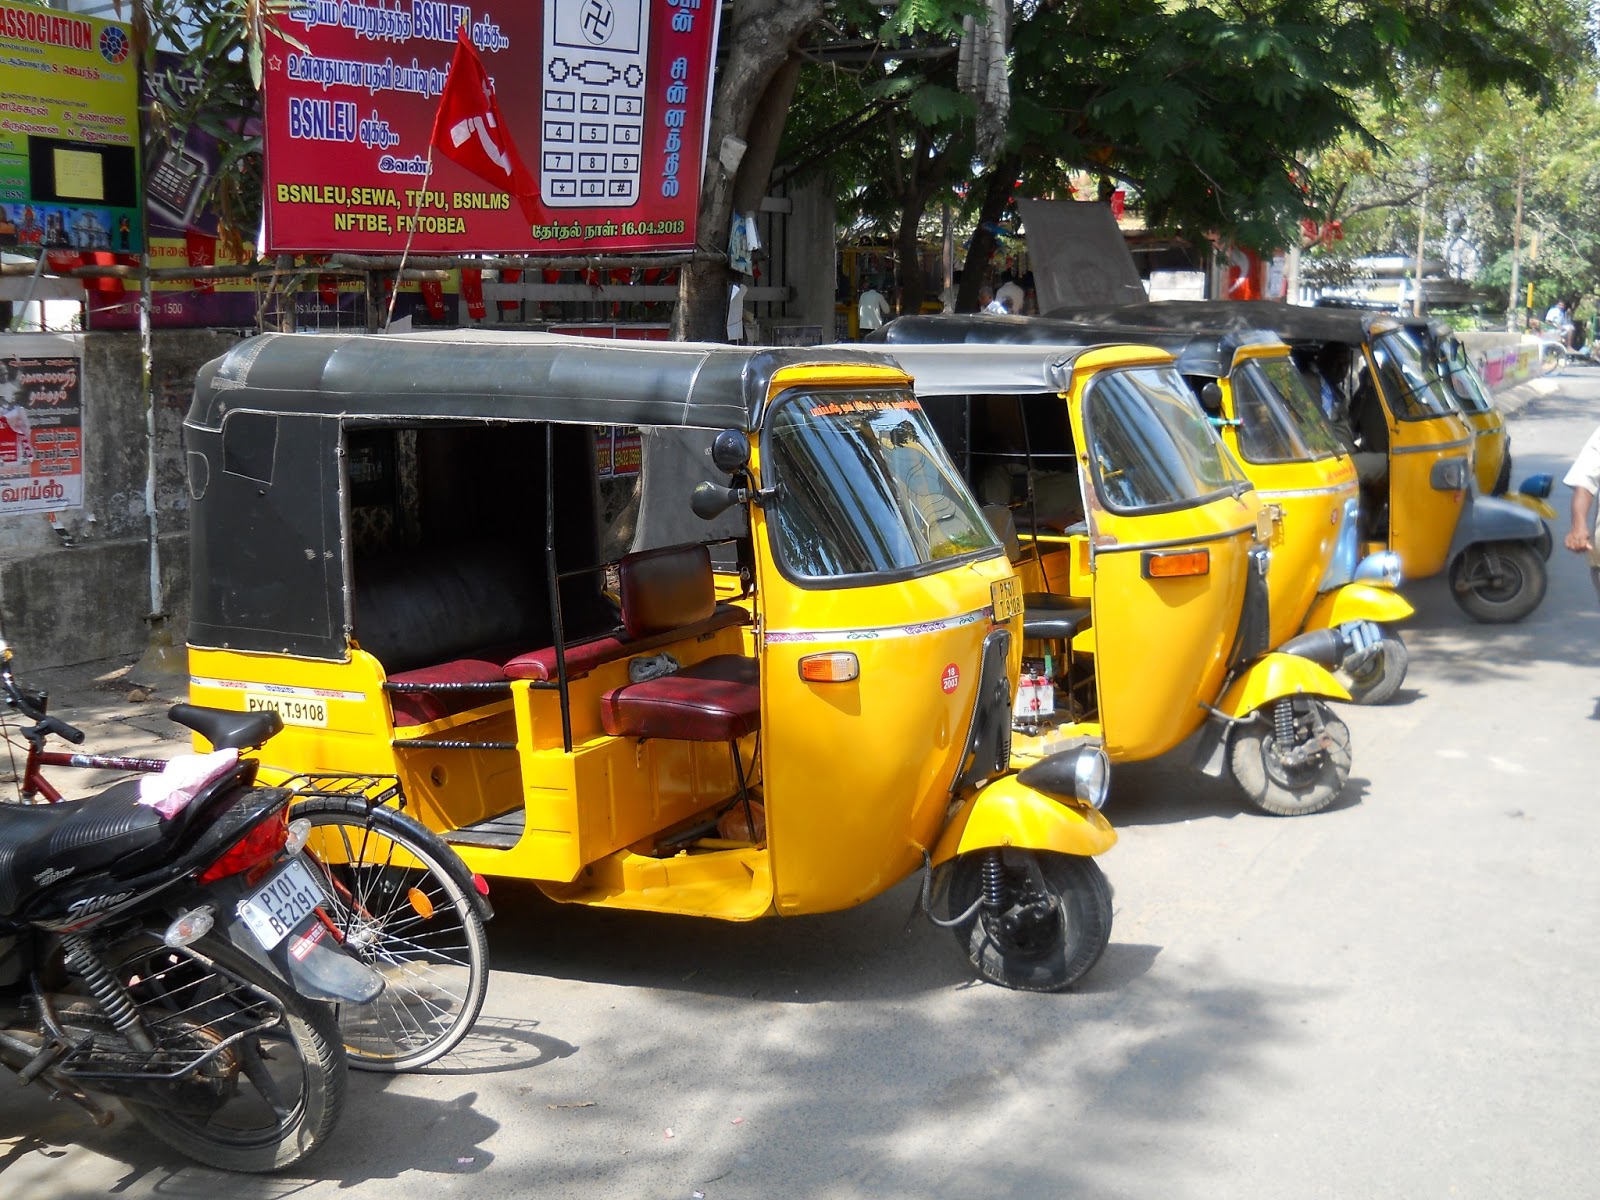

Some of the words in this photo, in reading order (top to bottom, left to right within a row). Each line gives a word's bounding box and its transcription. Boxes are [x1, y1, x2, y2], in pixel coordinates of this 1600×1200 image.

[0, 7, 93, 51] ASSOCIATION
[556, 96, 562, 109] 1
[592, 99, 598, 111] 2
[626, 101, 632, 112] 3
[289, 98, 357, 142] BSNLEU
[556, 126, 562, 138] 4
[591, 127, 597, 140] 5
[625, 129, 631, 141] 6
[555, 157, 561, 168] 7
[590, 157, 596, 169] 8
[623, 158, 629, 169] 9
[453, 192, 510, 210] BSNLMS
[334, 213, 392, 235] NFTBE,
[621, 220, 685, 236] 16.04.2013
[163, 303, 182, 314] 1500
[260, 873, 297, 912] PY01
[64, 888, 136, 925] Shine
[268, 886, 317, 936] BE2191
